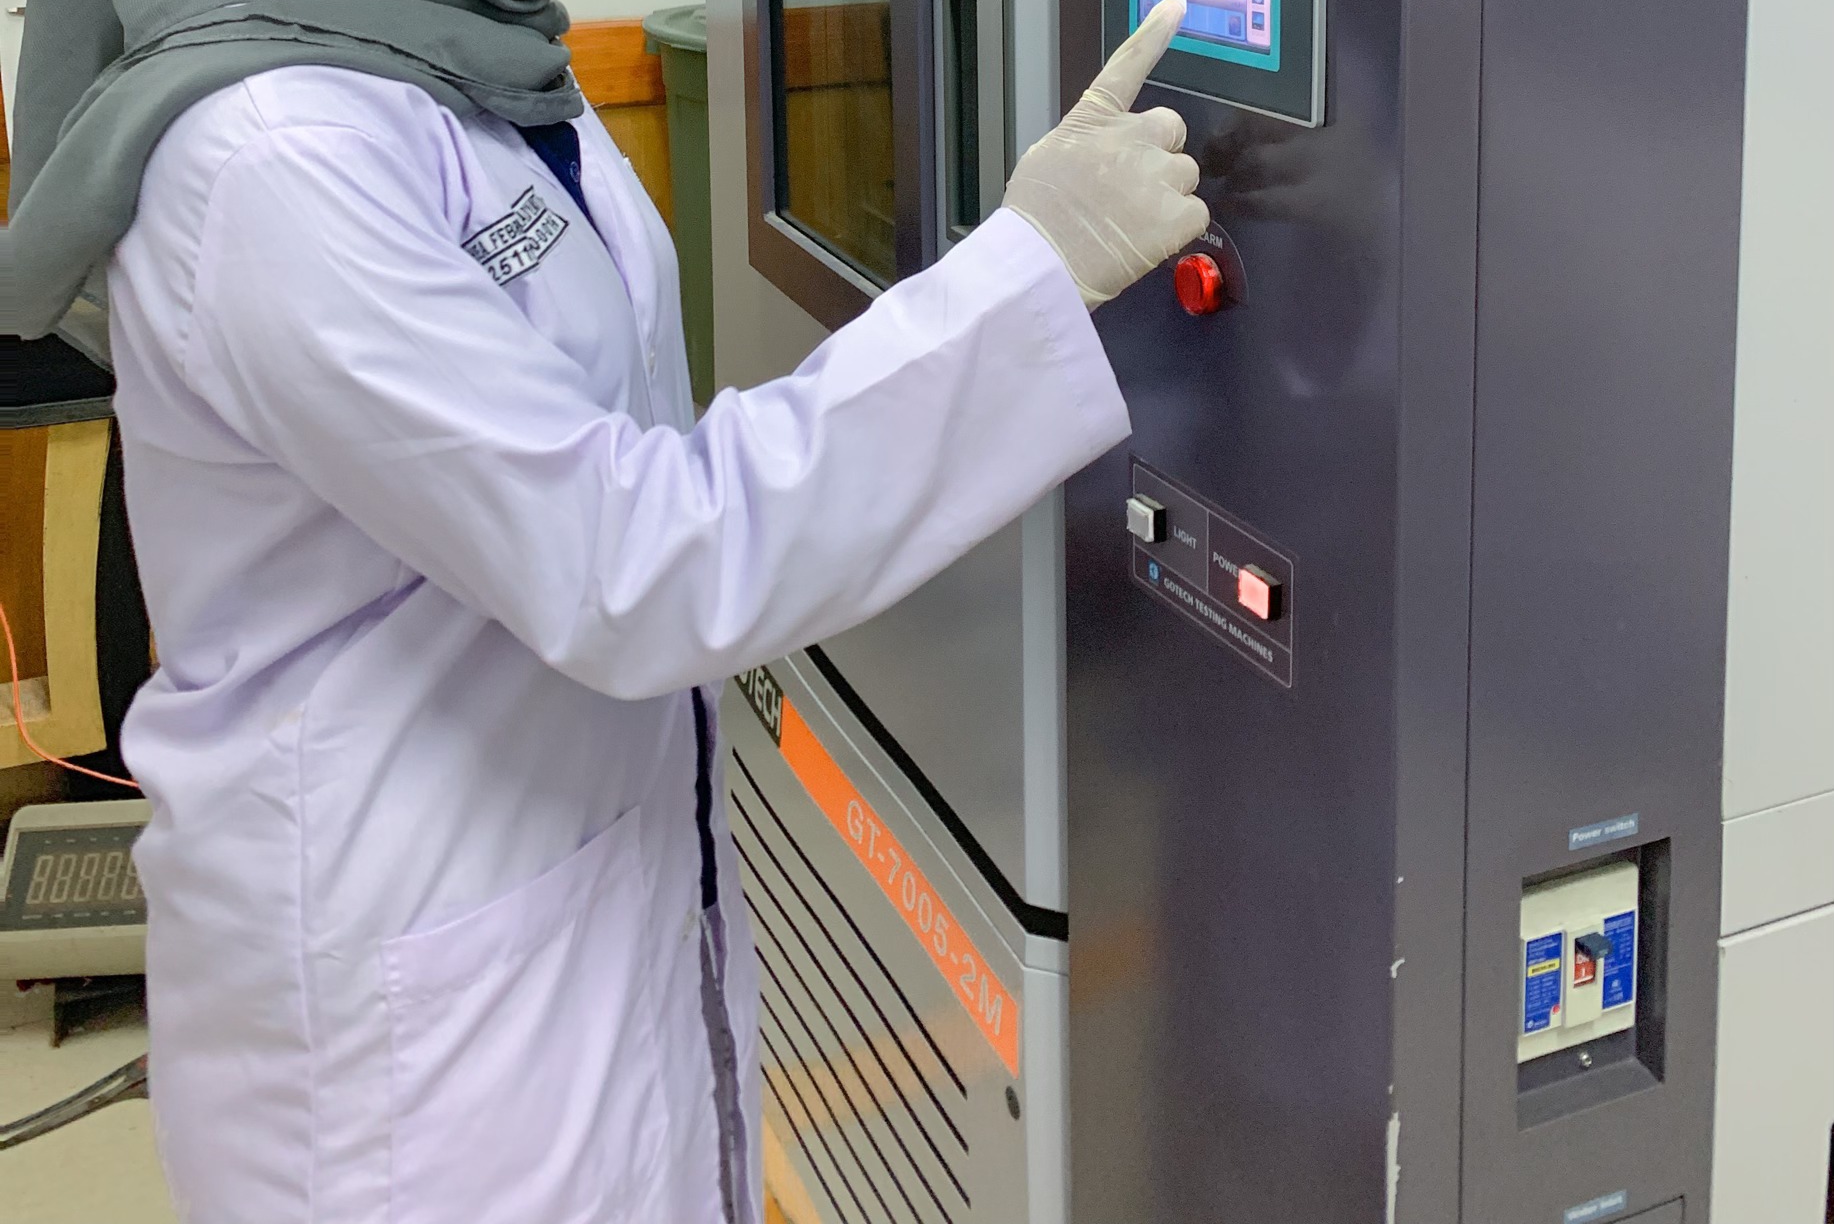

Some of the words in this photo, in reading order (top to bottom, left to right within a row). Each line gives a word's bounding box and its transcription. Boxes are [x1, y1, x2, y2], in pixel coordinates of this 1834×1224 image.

[1173, 526, 1198, 550] LIGHT
[1213, 551, 1240, 578] POWE
[1164, 578, 1194, 606] GOTECH
[1194, 594, 1227, 630] TESTING
[1229, 624, 1274, 663] MACHINES
[1572, 828, 1602, 843] Power
[1604, 819, 1635, 835] switch
[847, 800, 1003, 1036] GT-7005-2M
